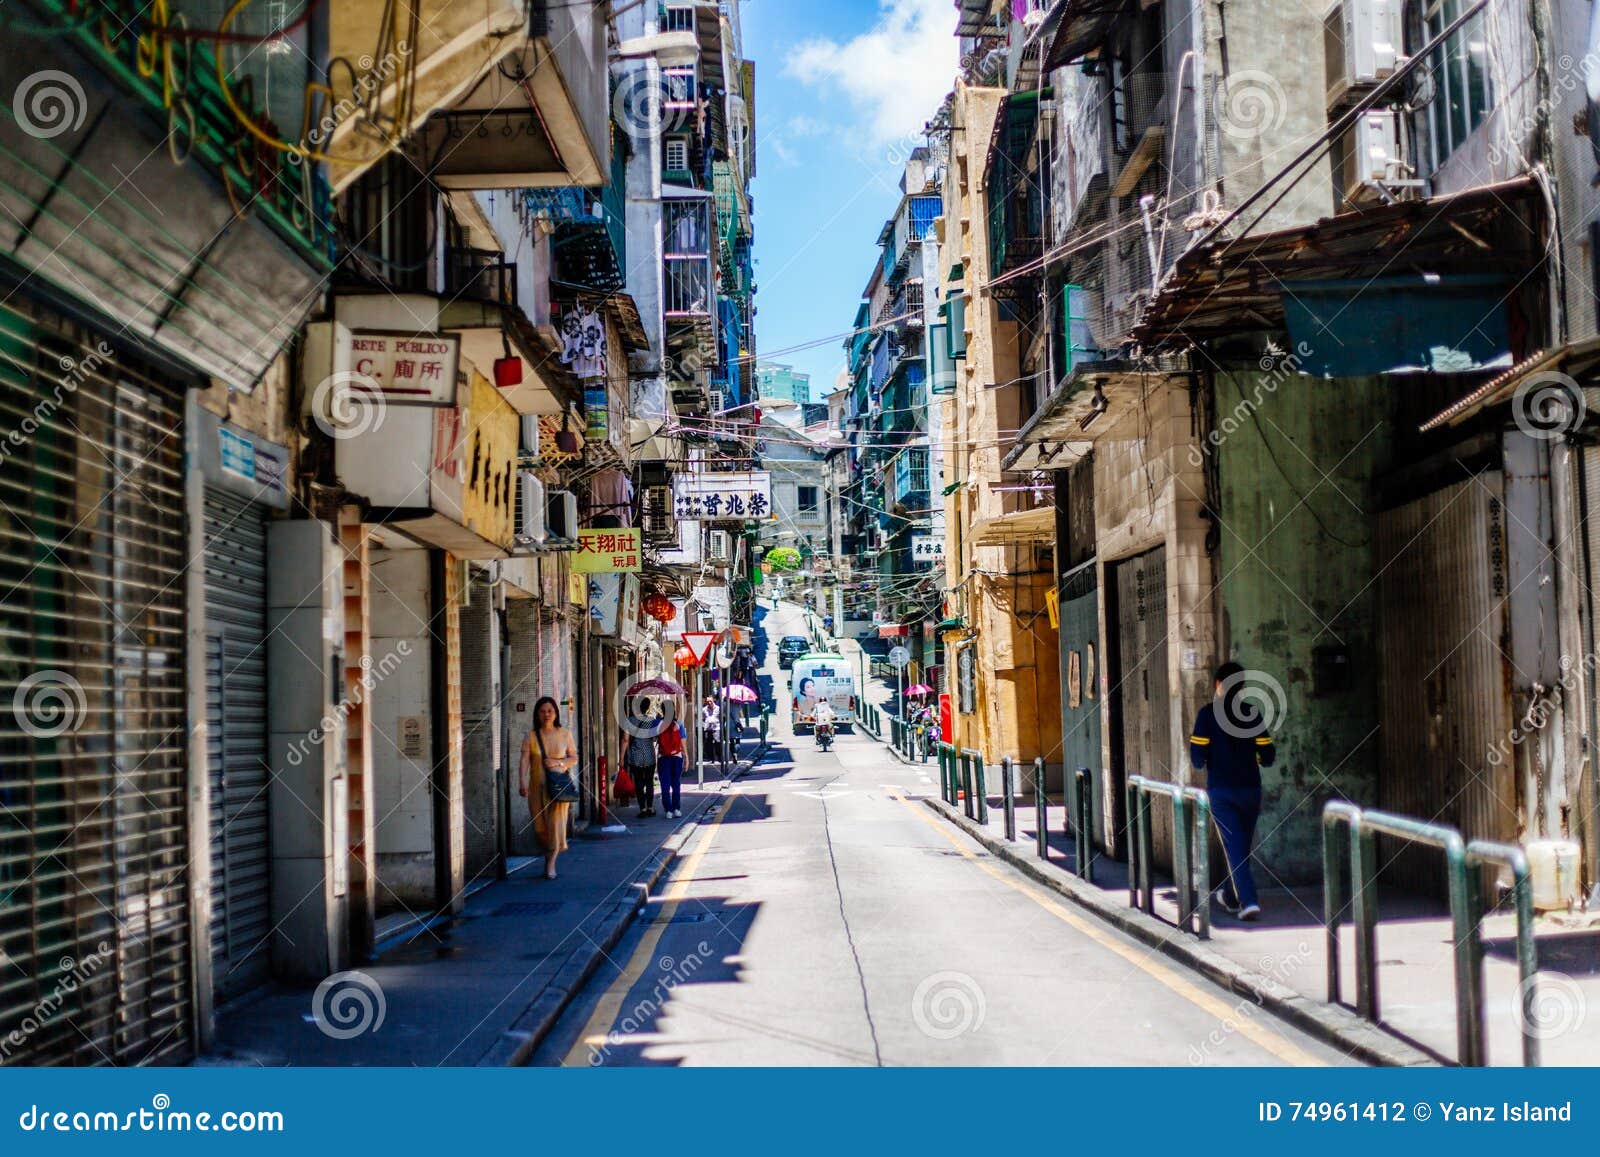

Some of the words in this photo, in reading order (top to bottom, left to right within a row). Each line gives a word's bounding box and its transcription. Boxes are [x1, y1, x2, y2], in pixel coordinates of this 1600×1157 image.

[352, 339, 386, 352] RETE
[577, 533, 637, 554] 天翔社
[612, 555, 637, 568] 玩具
